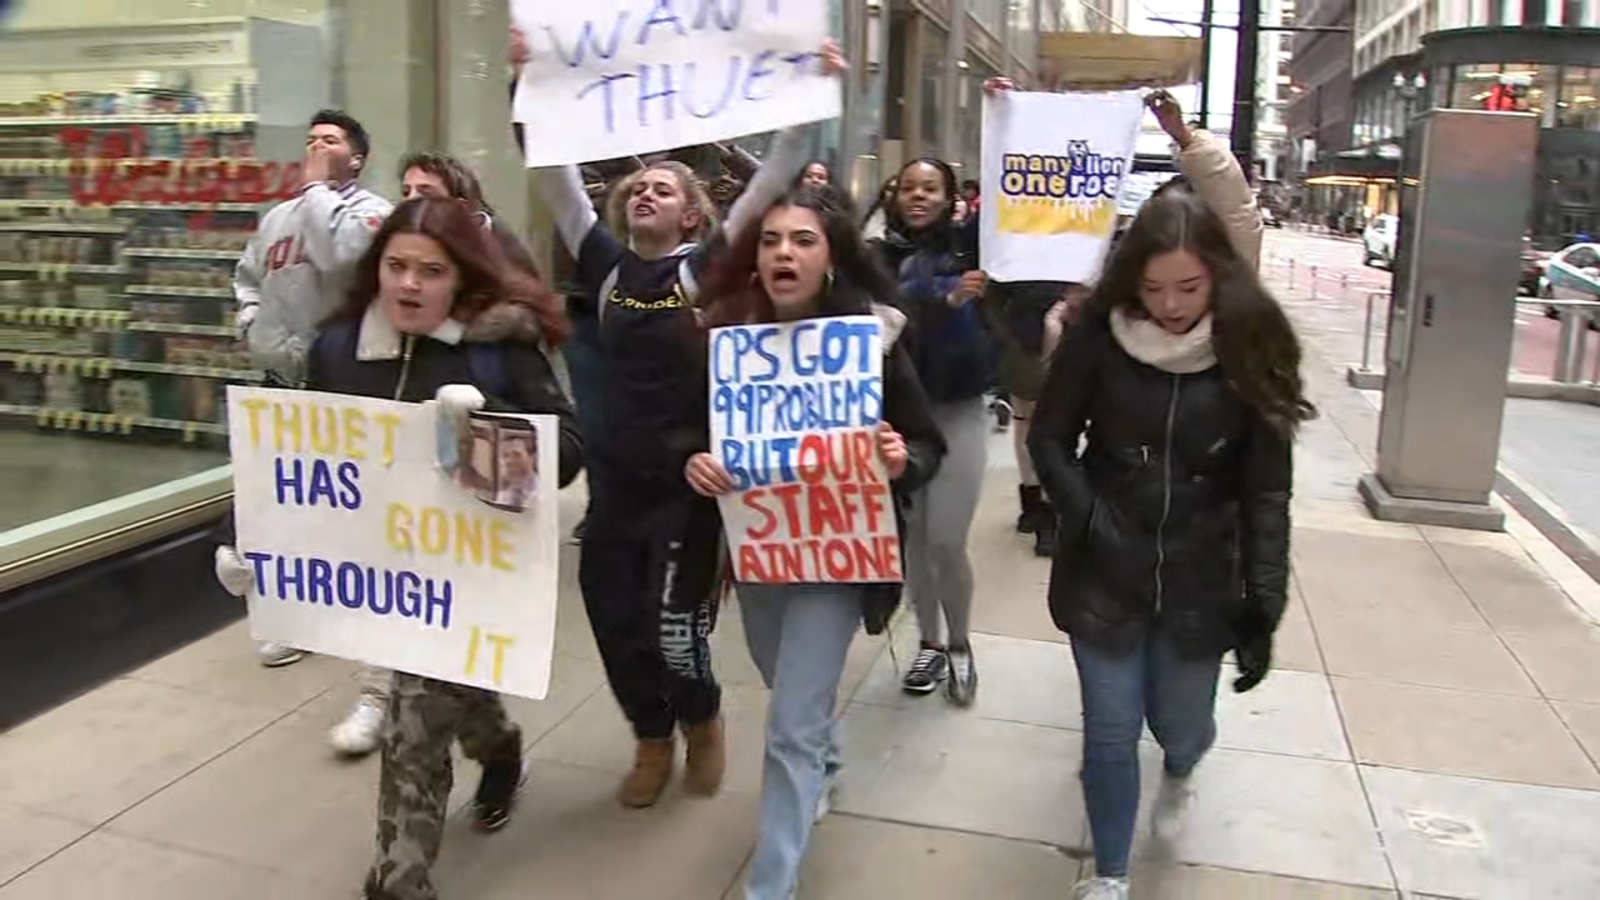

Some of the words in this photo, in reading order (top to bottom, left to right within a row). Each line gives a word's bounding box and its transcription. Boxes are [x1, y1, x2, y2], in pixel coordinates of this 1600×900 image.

[576, 50, 824, 132] THUET
[1001, 171, 1067, 198] one
[1003, 154, 1072, 176] many
[714, 327, 780, 384] CPS
[790, 321, 880, 376] GOT
[240, 398, 400, 468] THUET
[756, 377, 883, 433] PROBLEMS
[275, 457, 361, 510] HAS
[721, 437, 798, 490] BUT
[797, 431, 877, 483] OUR
[386, 503, 517, 572] GONE
[743, 483, 886, 539] STAFF
[245, 552, 452, 629] THROUGH
[463, 626, 515, 685] IT
